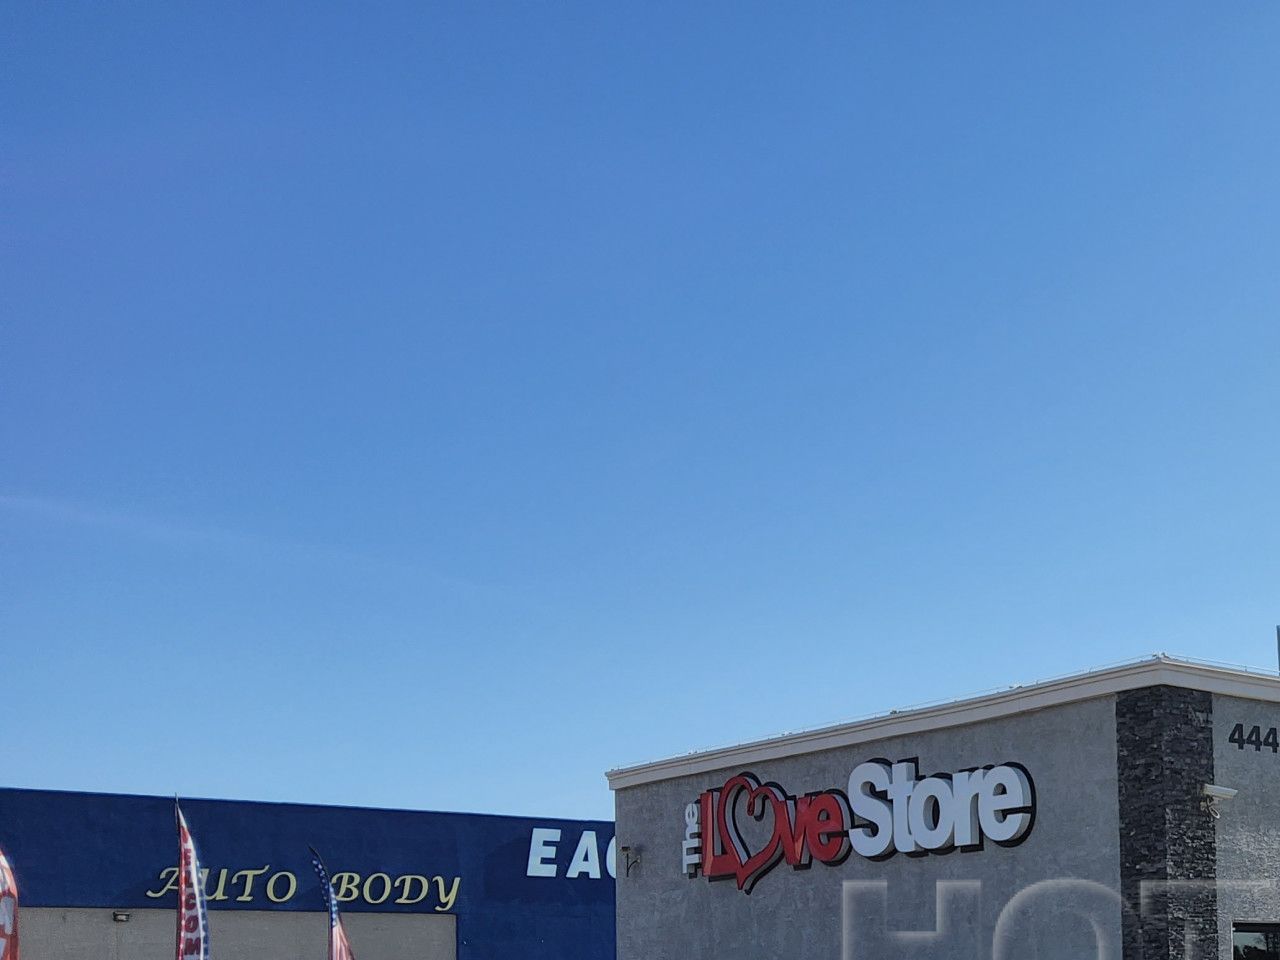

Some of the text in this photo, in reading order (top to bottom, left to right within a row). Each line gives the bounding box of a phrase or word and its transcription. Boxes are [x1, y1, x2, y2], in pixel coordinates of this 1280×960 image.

[681, 801, 701, 875] The
[849, 758, 1034, 859] Store
[330, 872, 461, 911] BODY
